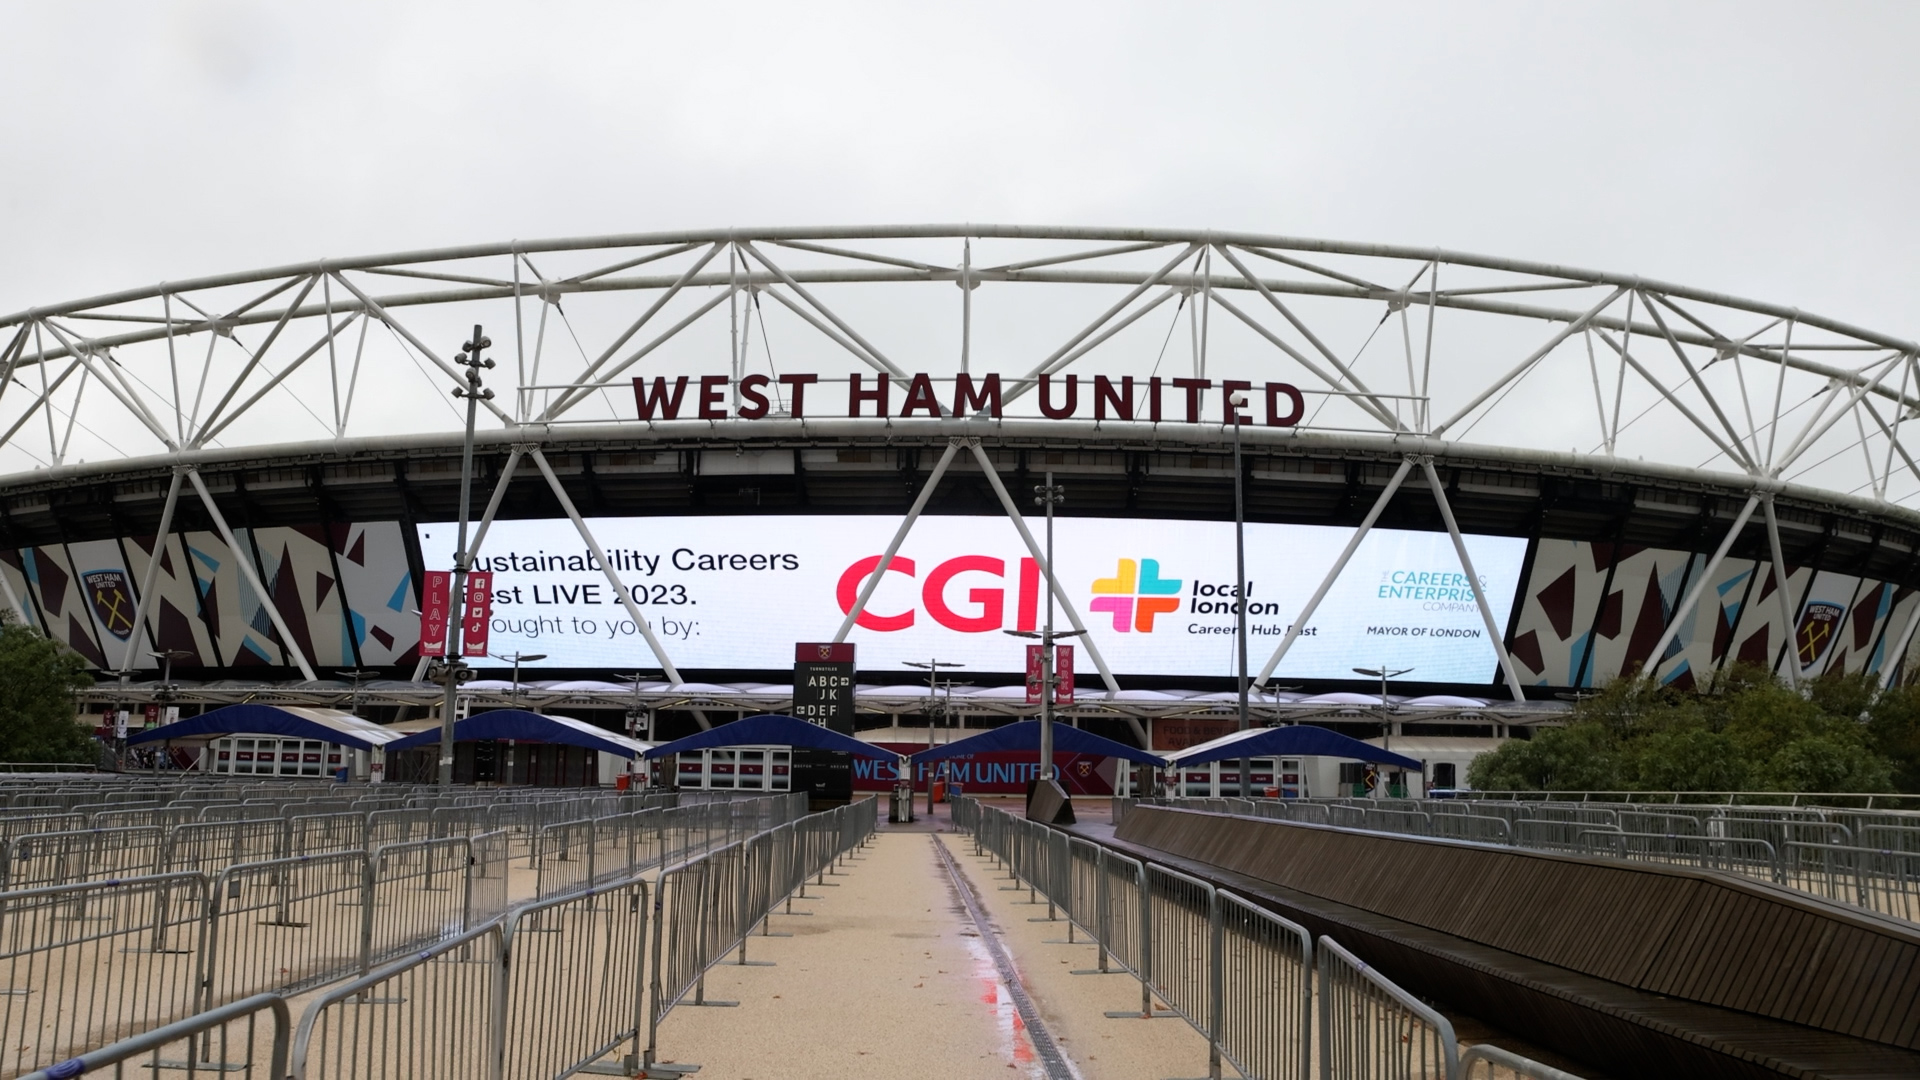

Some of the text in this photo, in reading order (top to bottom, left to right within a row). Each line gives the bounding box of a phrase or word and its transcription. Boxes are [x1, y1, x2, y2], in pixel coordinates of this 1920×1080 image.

[632, 373, 1304, 427] WEST HAM UNITED
[672, 548, 799, 571] Careers
[1392, 570, 1471, 587] CAREERS
[1478, 575, 1487, 588] &
[533, 584, 602, 604] LIVE
[836, 555, 1040, 633] CGI
[1378, 585, 1487, 602] ENTERPRIS
[429, 576, 443, 636] PLAY
[1423, 601, 1480, 613] COMPANY
[571, 616, 597, 634] to
[662, 616, 700, 640] by:
[1251, 624, 1282, 636] Hub
[1367, 626, 1481, 638] MAYOR OF LONDON
[1163, 726, 1190, 735] FOOD
